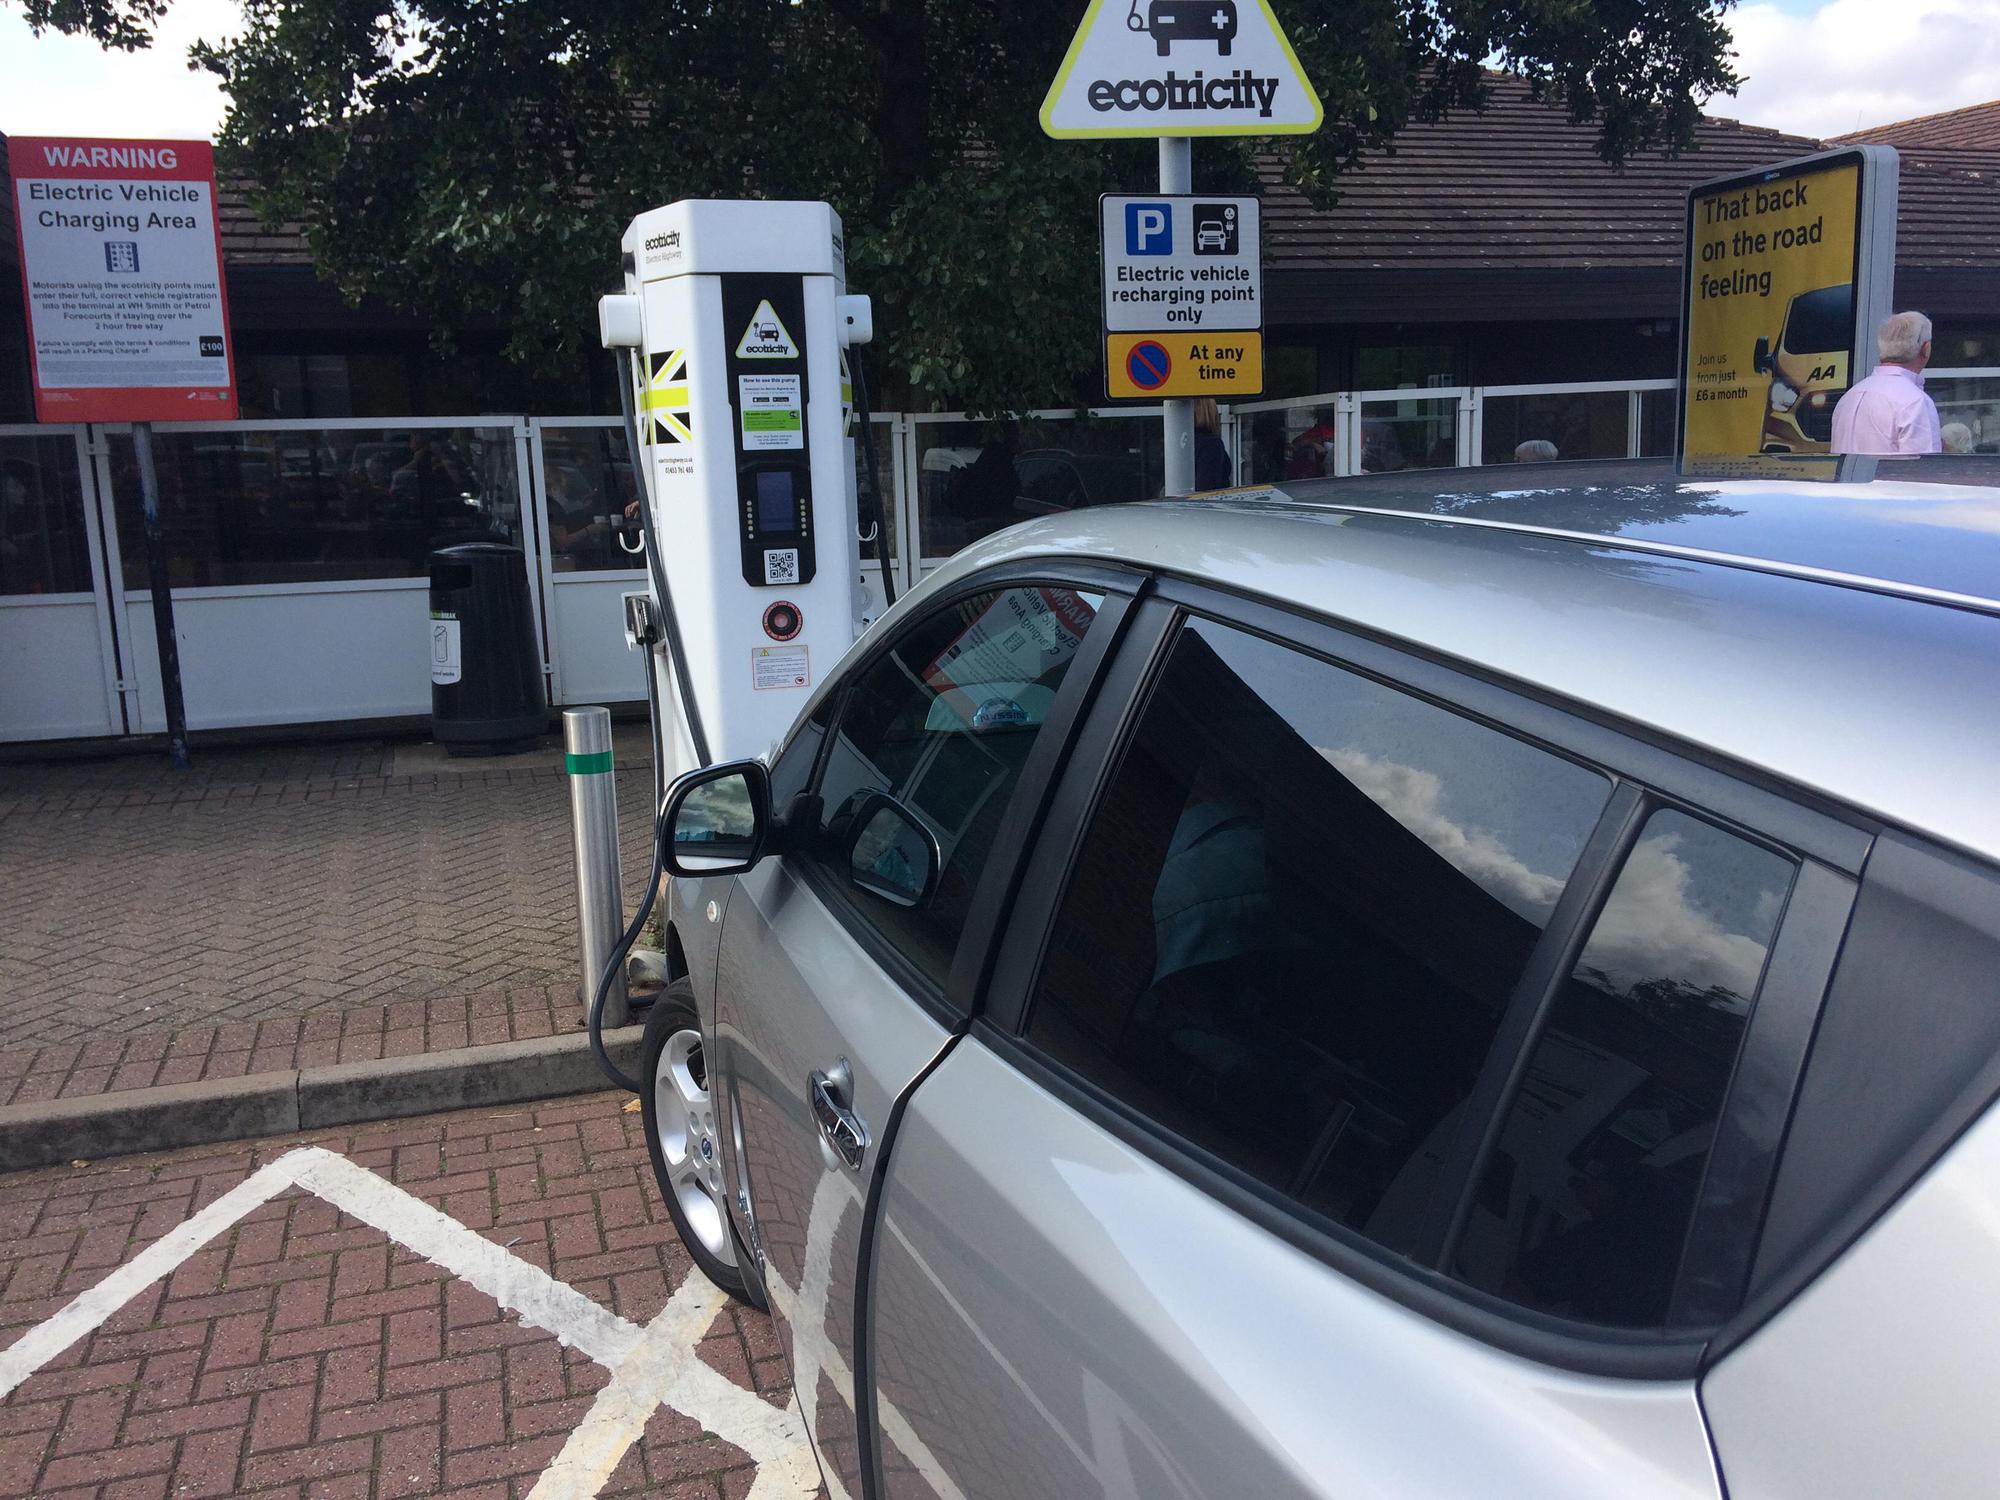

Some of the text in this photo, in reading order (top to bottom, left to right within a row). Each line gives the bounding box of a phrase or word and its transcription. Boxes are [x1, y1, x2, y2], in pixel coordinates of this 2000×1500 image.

[1088, 70, 1279, 117] ecotricity
[43, 146, 177, 168] WARNING
[29, 183, 199, 202] Electric Vehicle
[1703, 180, 1808, 224] That back
[38, 210, 196, 232] Charging Area
[1138, 210, 1165, 250] P
[645, 230, 680, 251] ecotricity
[1702, 216, 1822, 262] on the road
[1117, 266, 1250, 281] Electric vehicle
[77, 282, 102, 290] using
[121, 282, 161, 290] ecotricity
[164, 282, 191, 290] points
[1700, 268, 1771, 299] feeling
[167, 292, 217, 301] registration
[1112, 286, 1254, 304] recharging point
[63, 312, 112, 320] Forecourts
[1166, 306, 1203, 324] only
[145, 323, 164, 331] stay
[201, 343, 223, 351] £100
[746, 344, 789, 355] ecotricity
[1190, 345, 1244, 362] At any
[1697, 353, 1727, 366] Join us
[1199, 365, 1236, 380] time
[1697, 370, 1736, 383] from just
[1807, 365, 1836, 382] AA
[1696, 387, 1748, 401] £6 a month
